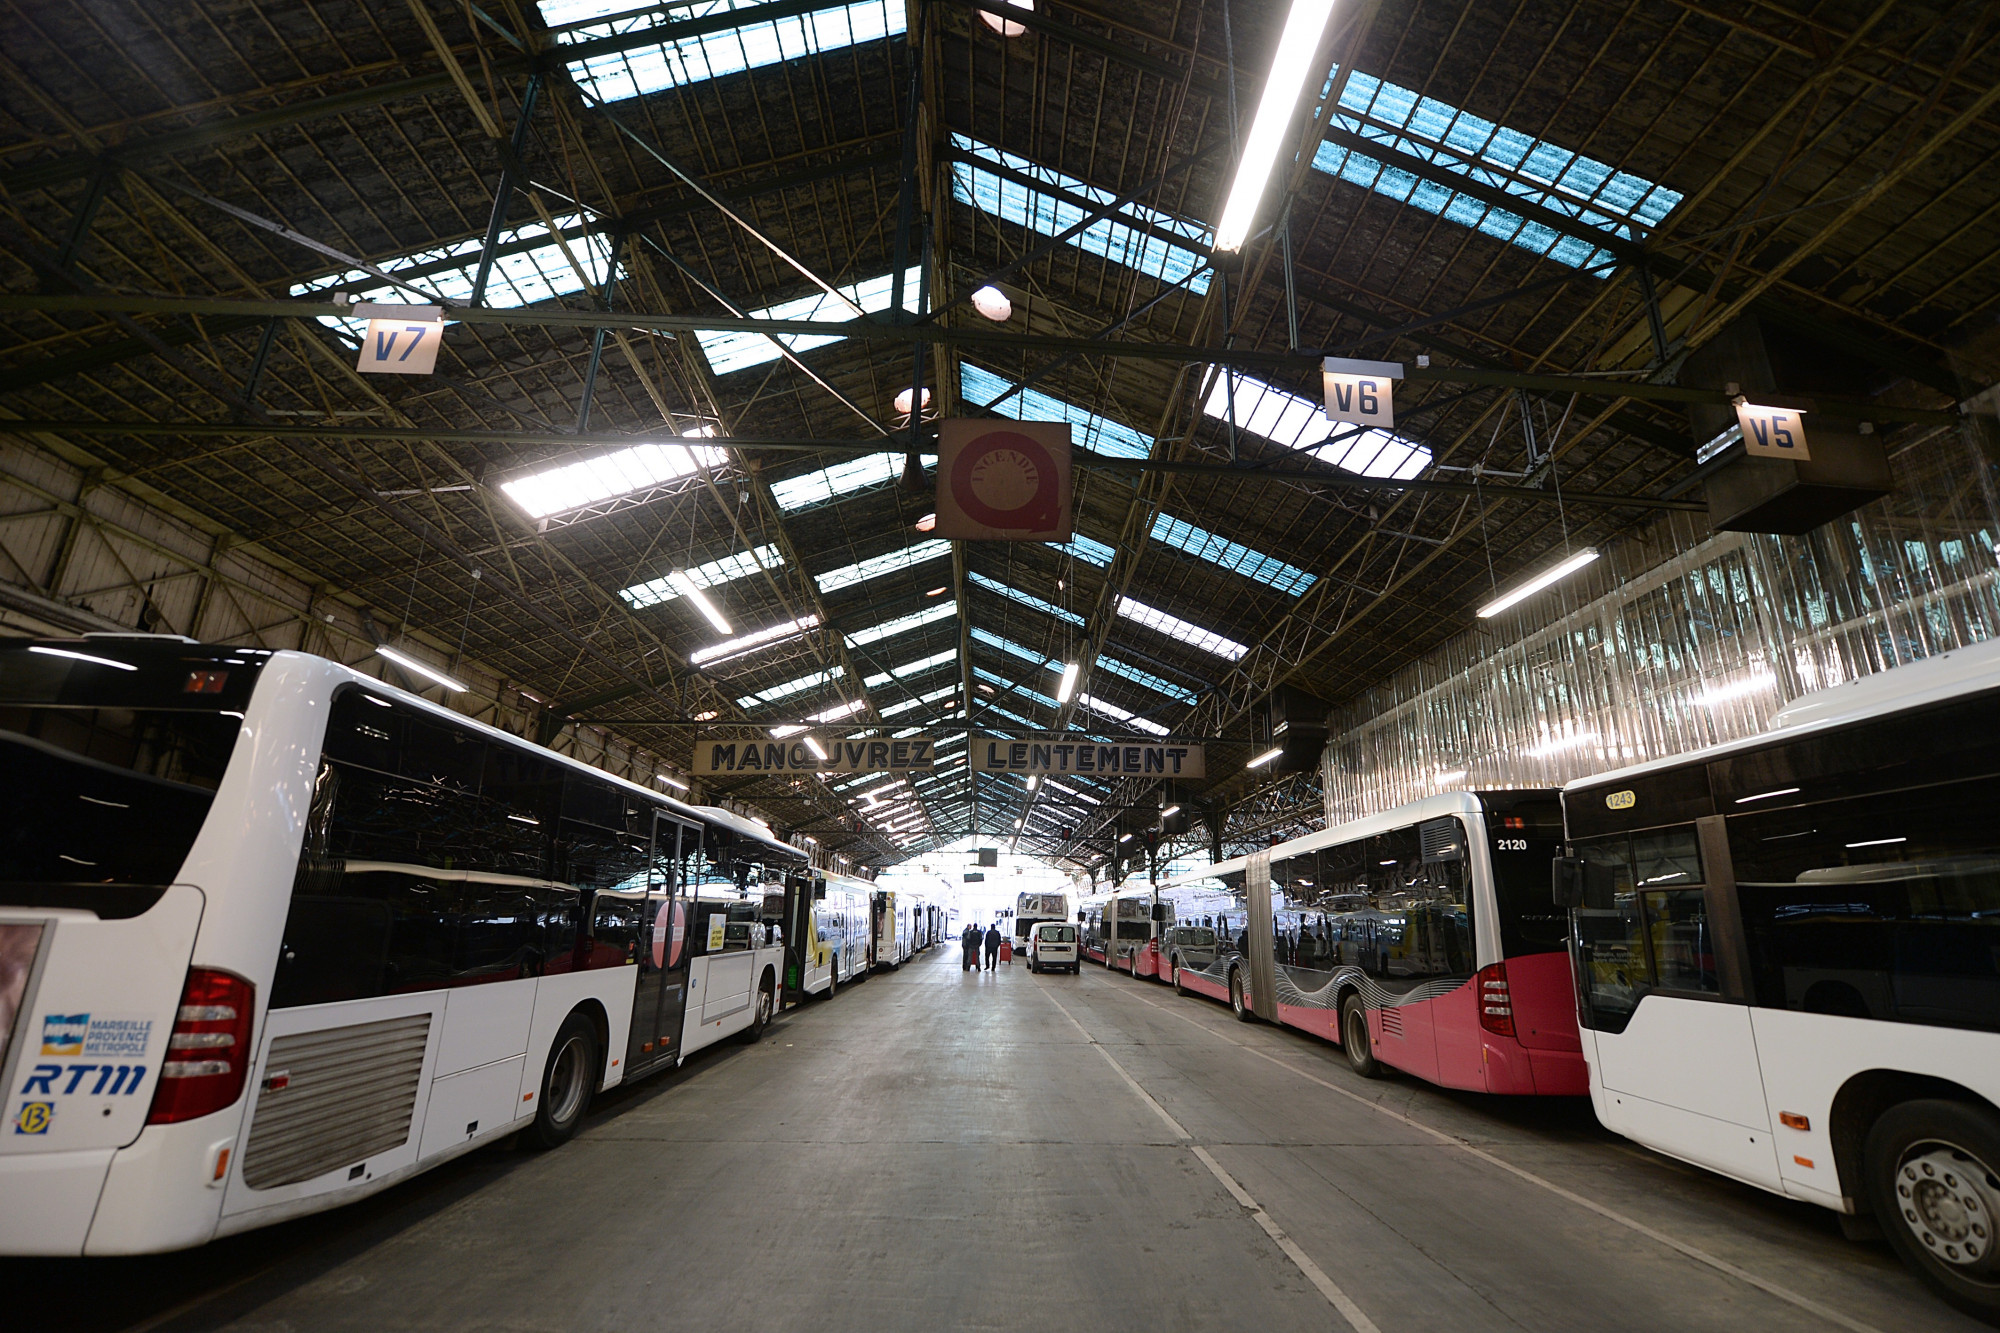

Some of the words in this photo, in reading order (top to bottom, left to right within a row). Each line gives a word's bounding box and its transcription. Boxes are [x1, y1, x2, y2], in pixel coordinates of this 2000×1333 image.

[375, 326, 427, 362] V7
[1334, 380, 1379, 415] V6
[1749, 415, 1794, 449] V5
[972, 450, 1039, 484] INCENDIE
[987, 742, 1187, 773] LENTEMENT
[1607, 791, 1633, 808] 1243
[1497, 839, 1527, 850] 2120
[87, 1031, 150, 1042] PROVENCE
[90, 1020, 153, 1031] MARSEILLE
[25, 1106, 45, 1130] 13
